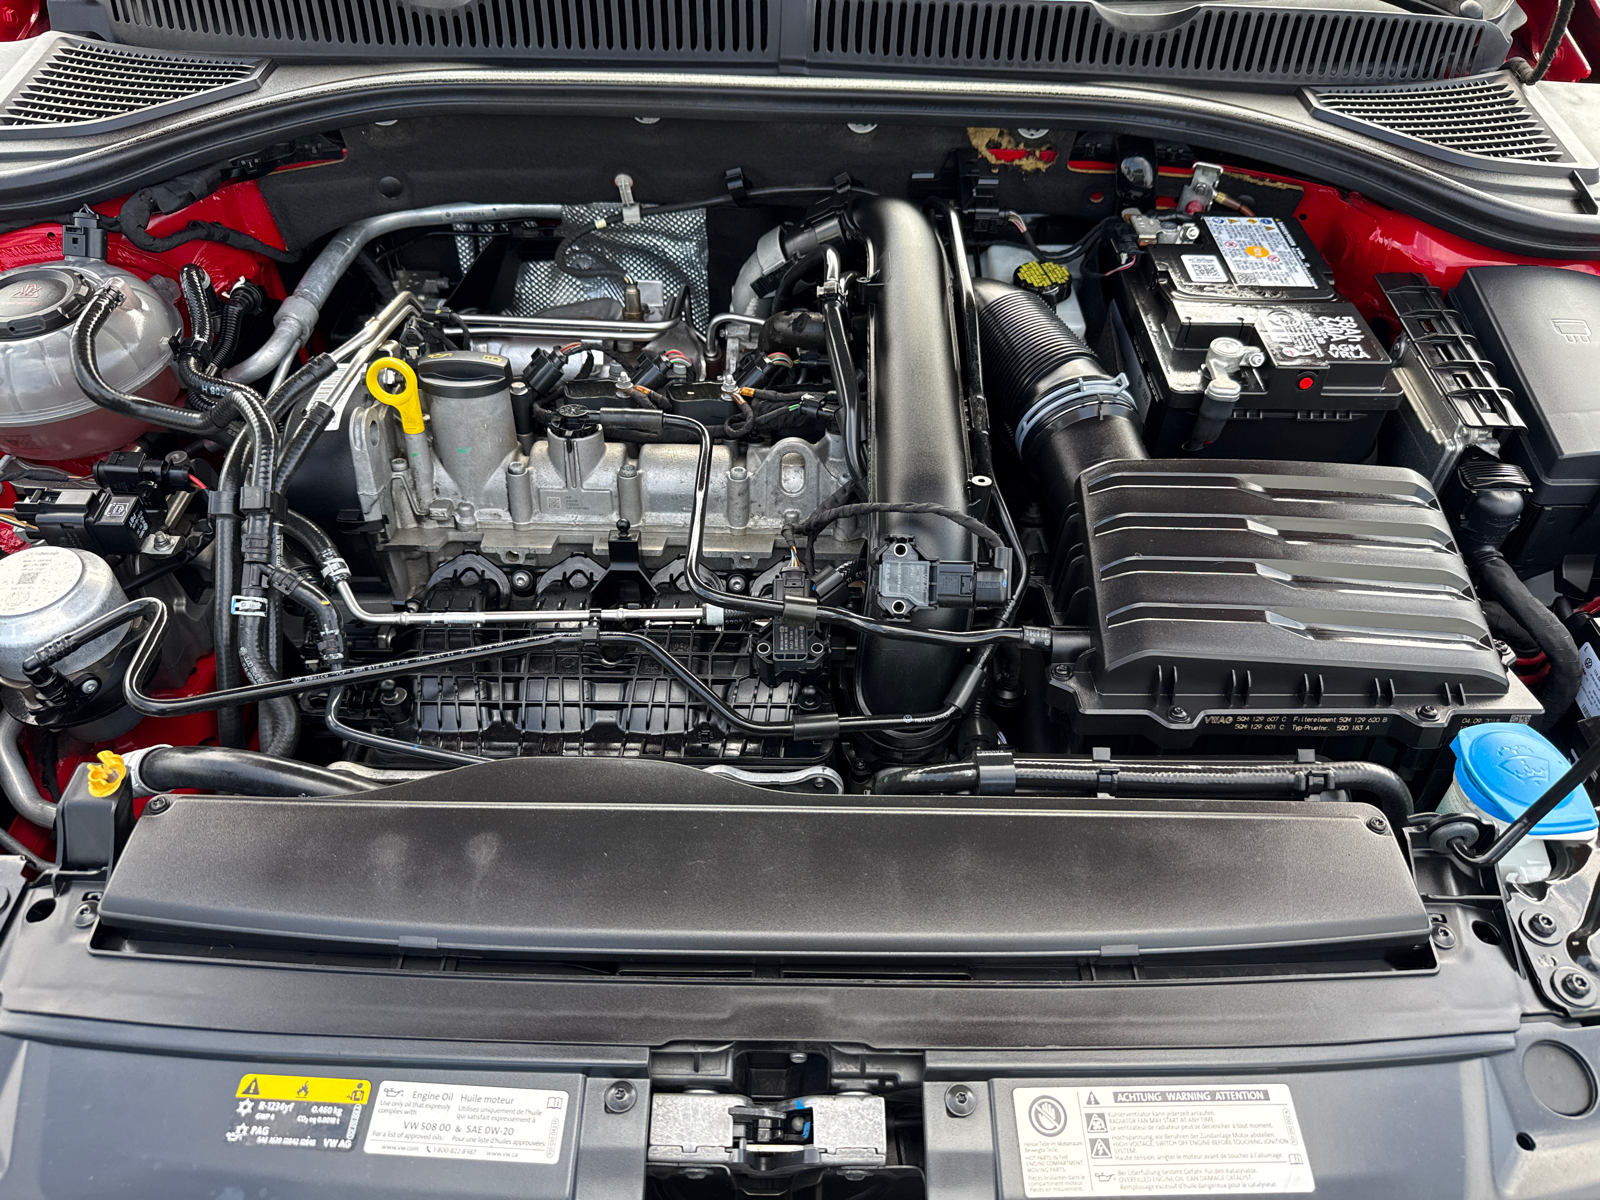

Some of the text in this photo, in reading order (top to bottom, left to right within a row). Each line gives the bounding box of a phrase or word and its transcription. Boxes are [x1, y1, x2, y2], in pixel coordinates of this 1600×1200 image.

[1329, 344, 1364, 352] AGM
[1328, 350, 1371, 359] VRLA
[412, 1091, 454, 1101] Engine Oil
[460, 1094, 514, 1104] Huile moteur
[1117, 1091, 1264, 1102] ACHTUNG WARNING ATTENTION
[392, 1100, 403, 1108] only
[425, 1103, 451, 1111] expressly
[458, 1105, 479, 1113] Utilisez
[480, 1106, 515, 1115] uniquement
[525, 1108, 542, 1116] l'huile
[491, 1115, 531, 1123] expressément
[250, 1125, 270, 1136] PAG
[403, 1121, 514, 1135] VW 508 00 & SAE 0W-20
[323, 1138, 338, 1148] VW
[338, 1139, 352, 1149] AG
[490, 1137, 512, 1145] d'huiles
